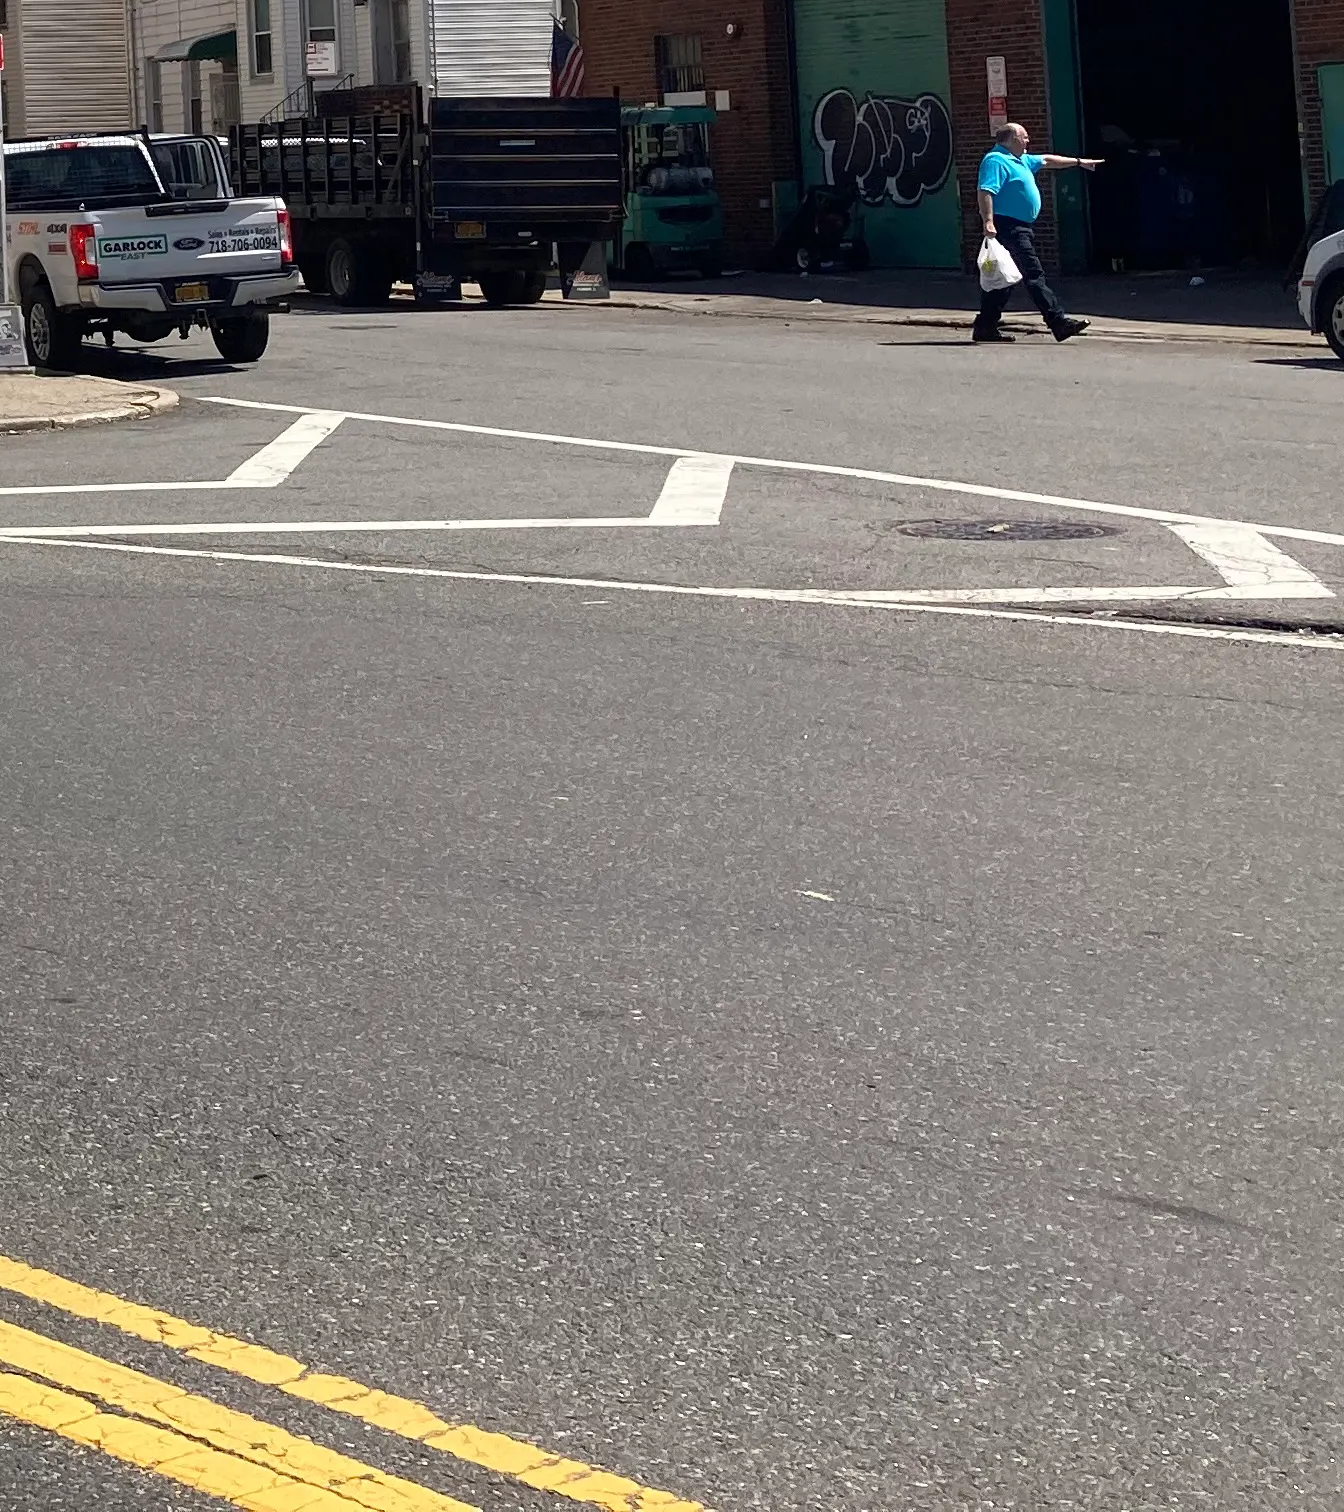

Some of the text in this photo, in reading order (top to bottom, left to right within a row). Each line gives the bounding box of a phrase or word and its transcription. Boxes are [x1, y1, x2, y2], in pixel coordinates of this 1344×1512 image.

[255, 226, 277, 235] Repairs
[103, 240, 162, 253] GARLOCK
[210, 237, 278, 254] 718-706-0094
[120, 252, 146, 261] EAST
